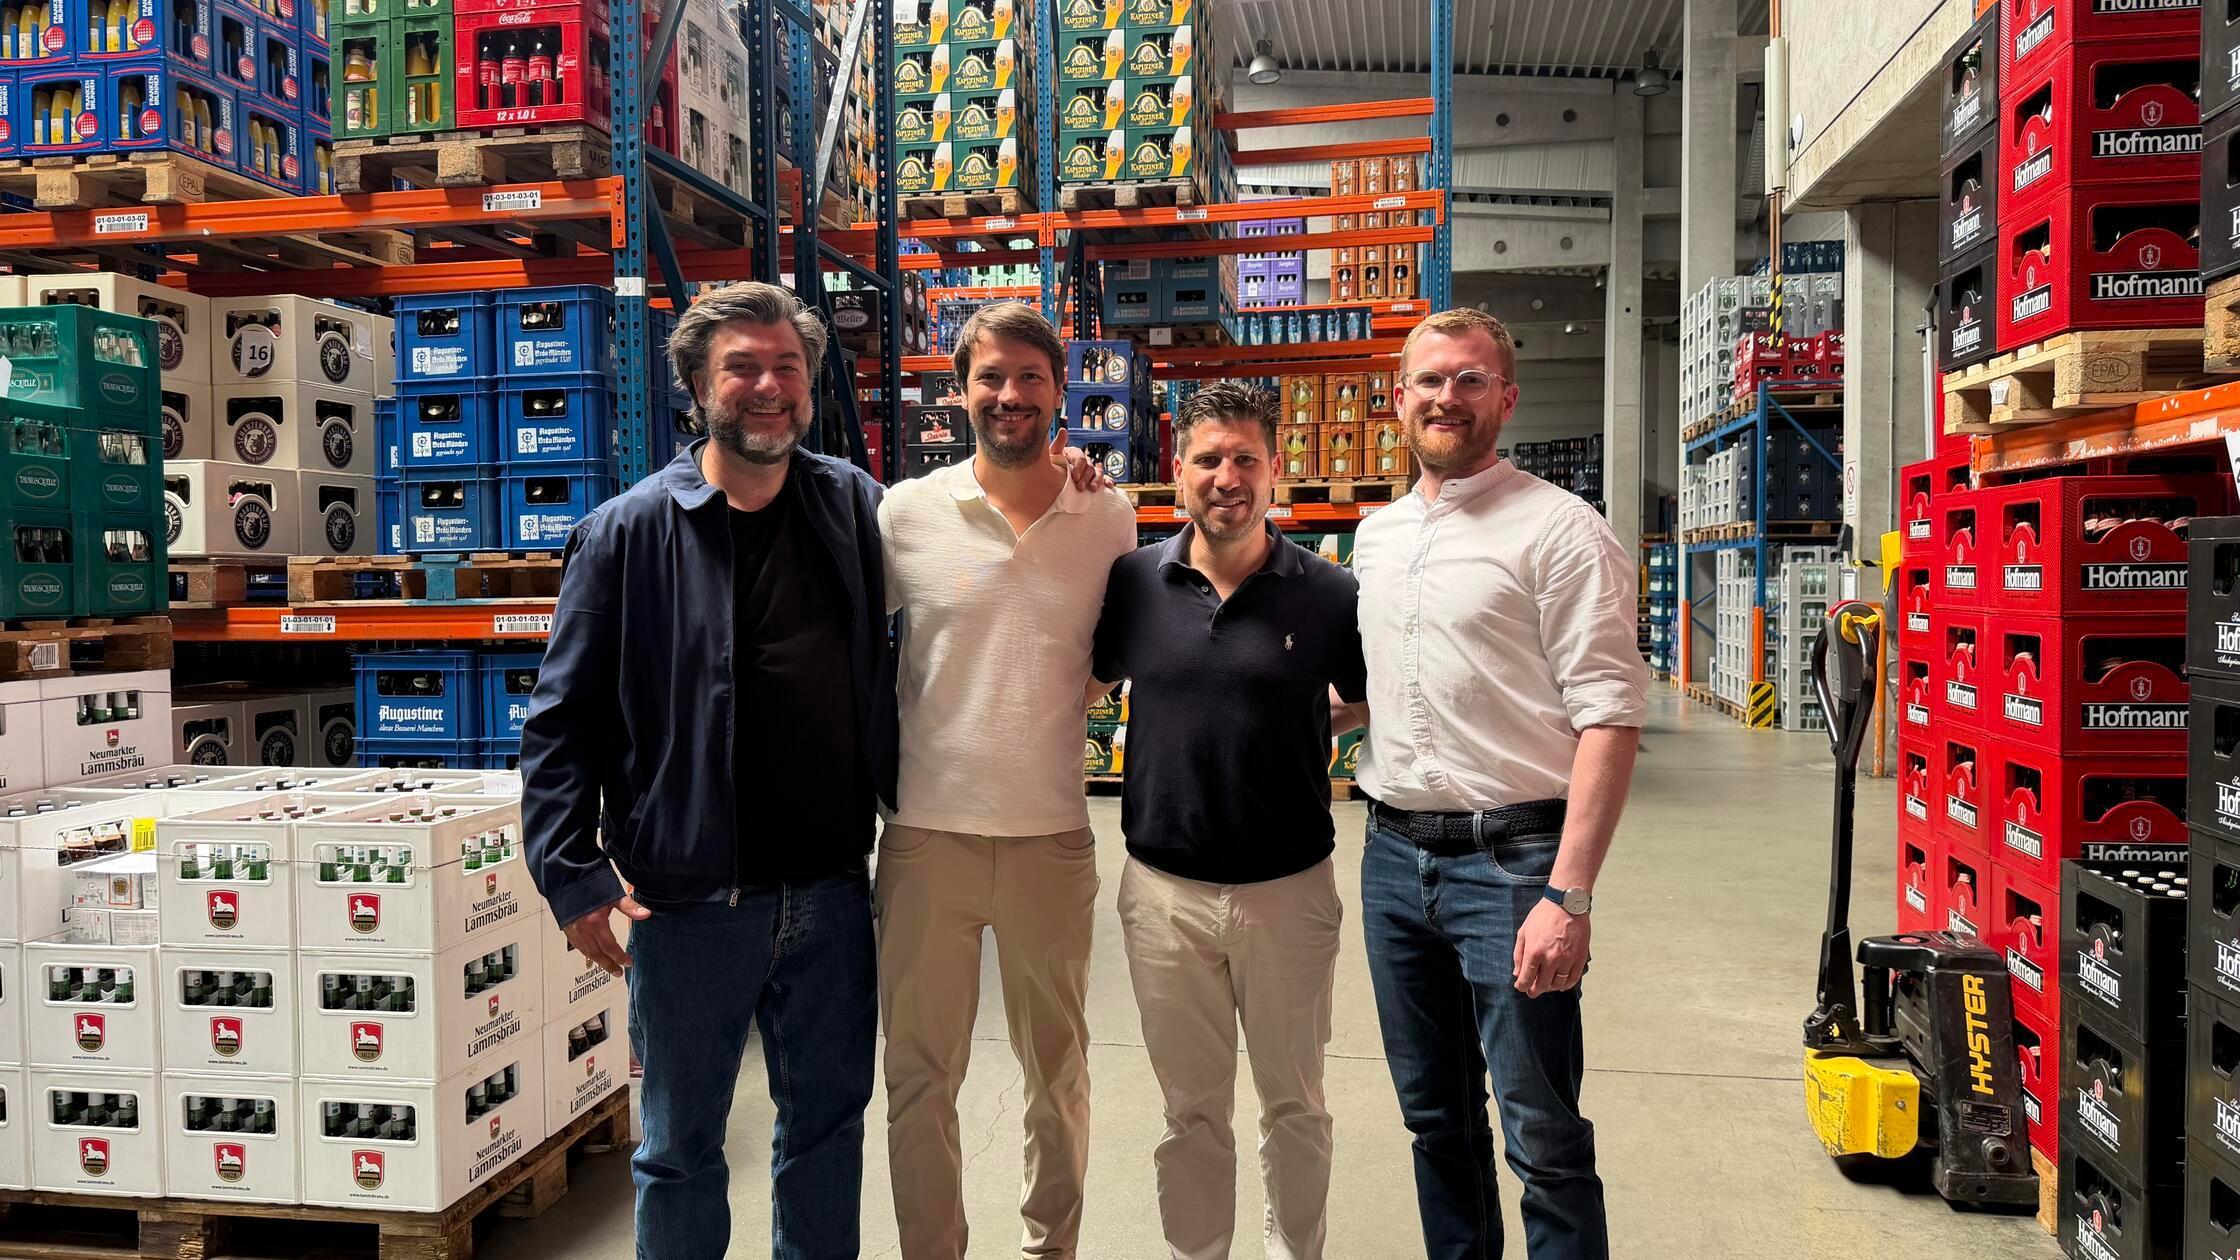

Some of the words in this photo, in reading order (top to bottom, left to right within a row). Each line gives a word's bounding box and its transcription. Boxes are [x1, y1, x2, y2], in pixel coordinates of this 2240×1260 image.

[1064, 16, 1098, 24] KAPUZINER
[1130, 12, 1164, 20] KAPUZINER
[954, 26, 987, 35] KAPUZINER
[2016, 15, 2052, 56] Hofmann
[1064, 66, 1098, 74] KAPUZINER
[1130, 62, 1164, 70] KAPUZINER
[956, 76, 988, 86] KAPUZINER
[496, 111, 506, 121] 12
[517, 110, 528, 120] 1.0
[530, 110, 536, 120] L
[1064, 116, 1098, 124] KAPUZINER
[1130, 113, 1164, 122] KAPUZINER
[1954, 96, 1979, 128] Hofmann
[957, 125, 990, 133] KAPUZINER
[2099, 132, 2202, 155] Hofmann
[958, 174, 991, 182] KAPUZINER
[1064, 166, 1098, 174] KAPUZINER
[1130, 163, 1165, 172] KAPUZINER
[2013, 152, 2050, 191] Hofmann
[182, 174, 200, 192] EPAL
[484, 192, 538, 202] 01-03-01-03-01
[96, 214, 146, 224] 01-03-01-03-02
[1953, 213, 1980, 240] Hofmann
[2097, 275, 2203, 298] Hofmann
[2012, 291, 2050, 321] Hofmann
[836, 312, 864, 324] Weller
[1953, 326, 1980, 349] Hofmann
[249, 345, 268, 361] 16
[2092, 364, 2122, 378] EPAL
[1909, 522, 1931, 538] Hofmann
[1946, 566, 1975, 586] Hofmann
[2004, 568, 2040, 588] Hofmann
[282, 616, 334, 624] 01-03-01-01-01
[496, 615, 550, 623] 01-03-01-02-01
[1908, 614, 1928, 630] Hofmann
[2218, 625, 2240, 651] Hof
[1948, 682, 1976, 707] Hofmann
[379, 705, 444, 723] Augustiner
[509, 704, 528, 721] Au
[1908, 708, 1928, 724] Hofmann
[2005, 696, 2040, 724] Hofmann
[90, 744, 137, 760] Neumarkter
[80, 755, 145, 776] Lammsbräu
[1906, 798, 1926, 820] Hofmann
[2218, 786, 2240, 815] Hof
[1948, 798, 1976, 827] Hofmann
[2006, 823, 2041, 859] Hofmann
[472, 890, 512, 914] Neumarkter
[1906, 886, 1926, 913] Hofmann
[465, 901, 518, 933] Lammsbräu
[2007, 948, 2042, 992] Hofmann
[2218, 944, 2240, 978] Hof
[2080, 954, 2119, 997] Hofmann
[568, 970, 611, 1004] Lammsbräu
[475, 1009, 514, 1037] Neumarkter
[468, 1021, 520, 1058] Lammsbräu
[1962, 974, 1994, 1096] HYSTER
[576, 1068, 606, 1095] Neumarkter
[570, 1077, 612, 1114] Lammsbräu
[2080, 1092, 2118, 1142] Hofmann
[2216, 1102, 2240, 1139] Hof
[476, 1128, 515, 1160] Neumarkter
[469, 1139, 522, 1183] Lammsbräu
